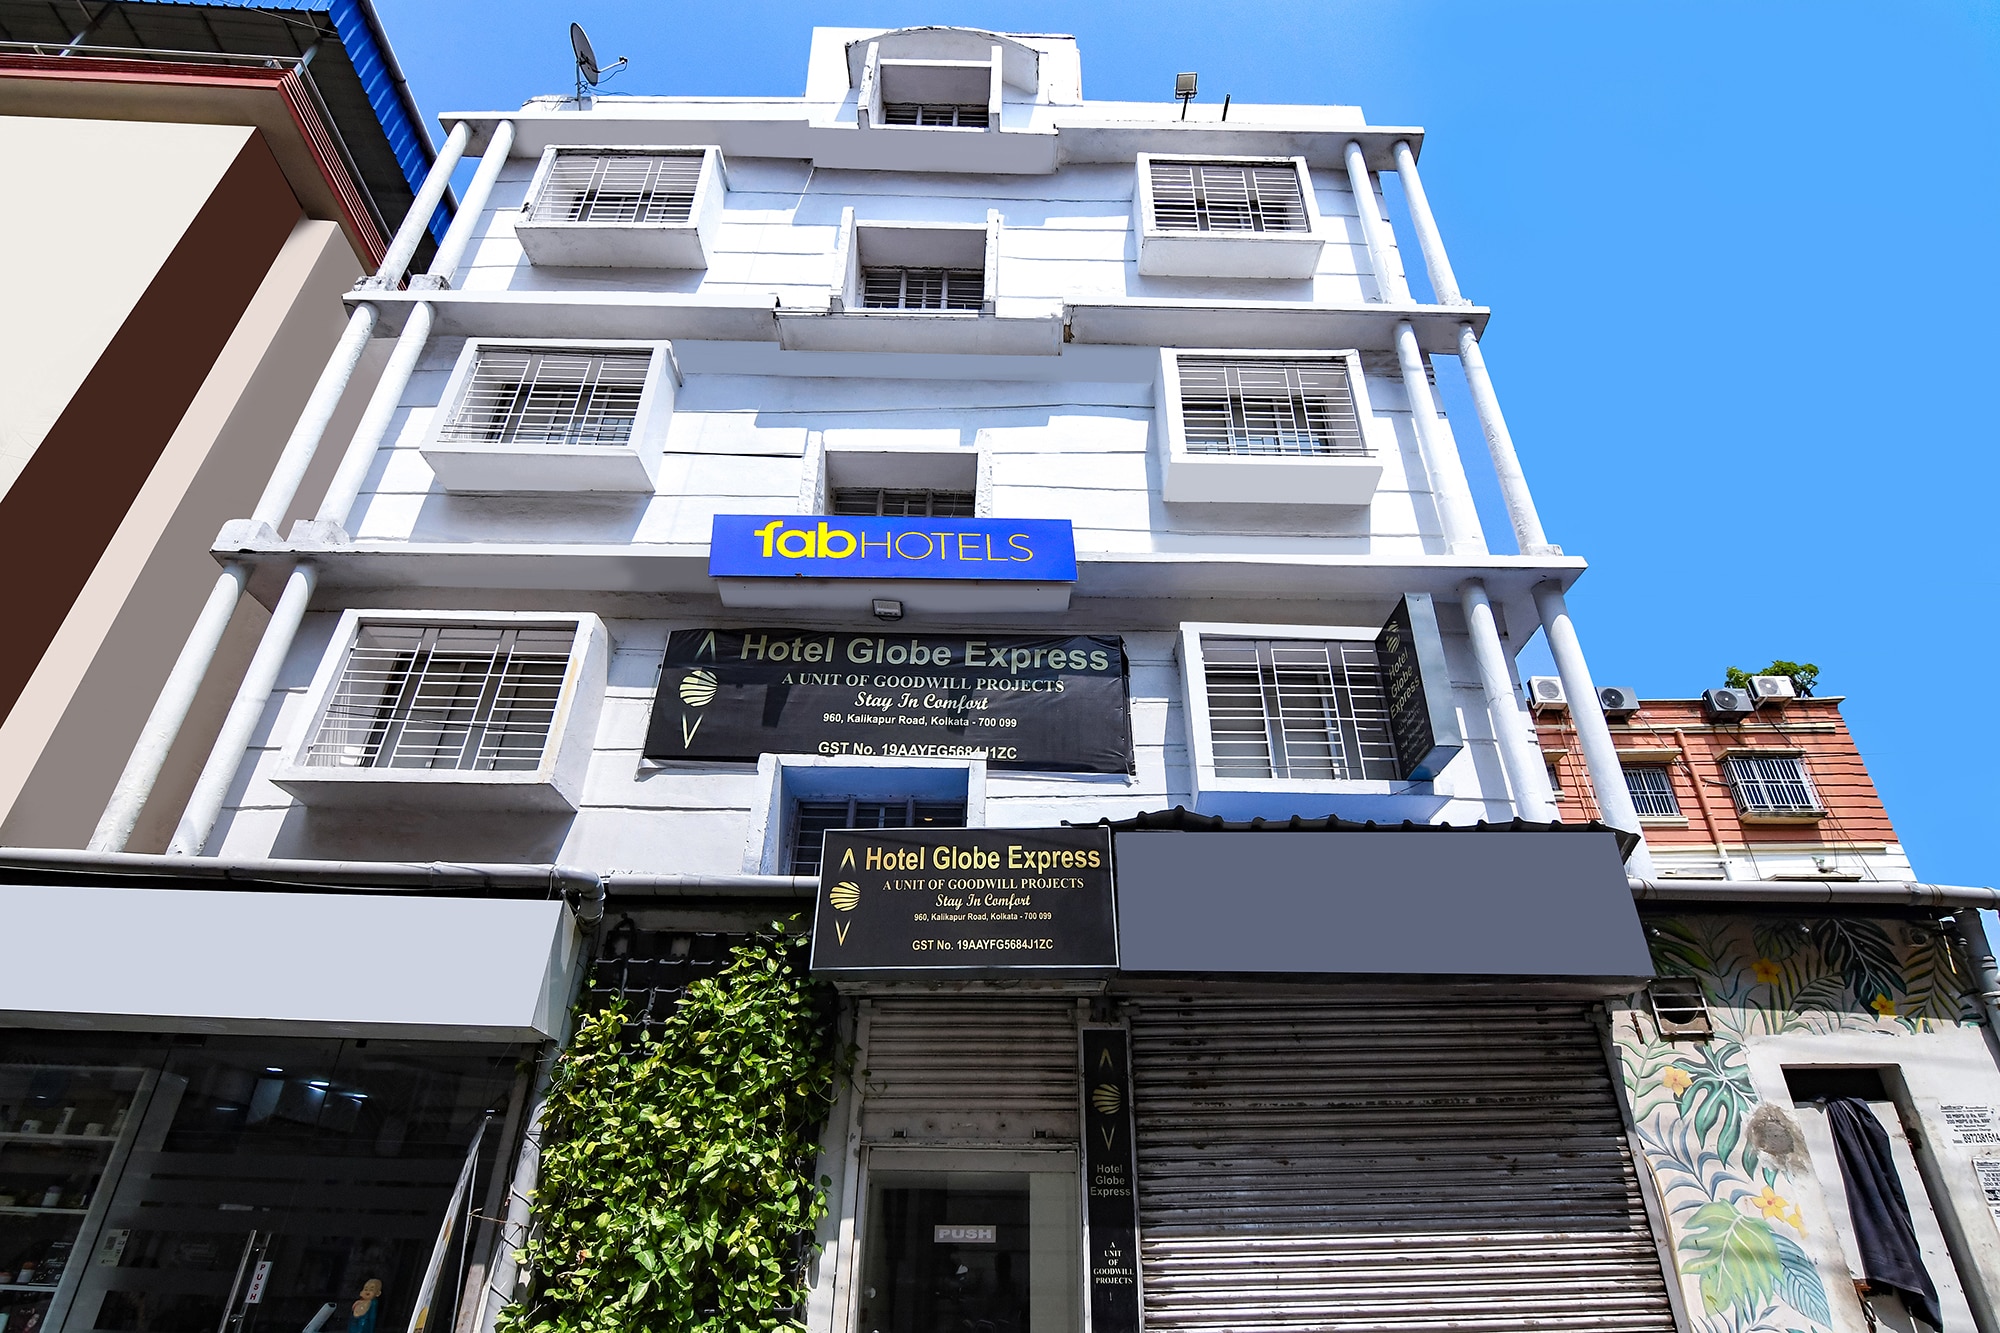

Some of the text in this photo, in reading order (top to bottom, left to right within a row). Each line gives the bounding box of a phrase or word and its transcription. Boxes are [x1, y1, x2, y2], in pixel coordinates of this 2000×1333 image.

[753, 520, 1034, 562] fabHOTELS
[740, 633, 1109, 675] Hotel Globe Express
[1389, 646, 1408, 680] Hotel
[781, 673, 1065, 693] A UNIT OF GOODWILL PROJECTS
[1391, 666, 1412, 698] Globe
[854, 691, 989, 714] Stay In Comfort
[1390, 676, 1420, 719] Express
[823, 713, 844, 724] 960,
[846, 713, 897, 726] Kalikapur
[898, 715, 928, 727] Road,
[930, 716, 970, 727] Kolkata
[978, 717, 997, 728] 700
[999, 718, 1017, 728] 099
[818, 741, 850, 755] GST
[853, 743, 877, 756] No.
[865, 845, 1101, 875] Hotel Globe Express
[882, 877, 1084, 890] A UNIT OF GOODWILL PROJECTS
[935, 893, 1031, 911] Stay In Comfort
[914, 913, 930, 922] 960,
[931, 912, 966, 923] Kalikapur
[967, 912, 989, 922] Road,
[990, 912, 1018, 921] Kolkata
[1024, 912, 1038, 920] 700
[1038, 912, 1052, 920] 099
[912, 938, 1054, 951] GST No. 19AAYFG5684J1ZC
[1096, 1164, 1123, 1174] Hotel
[1095, 1175, 1125, 1185] Globe
[1090, 1186, 1131, 1198] Express
[938, 1229, 992, 1239] PUSH
[1109, 1241, 1116, 1249] A
[250, 1264, 267, 1301] PUSH
